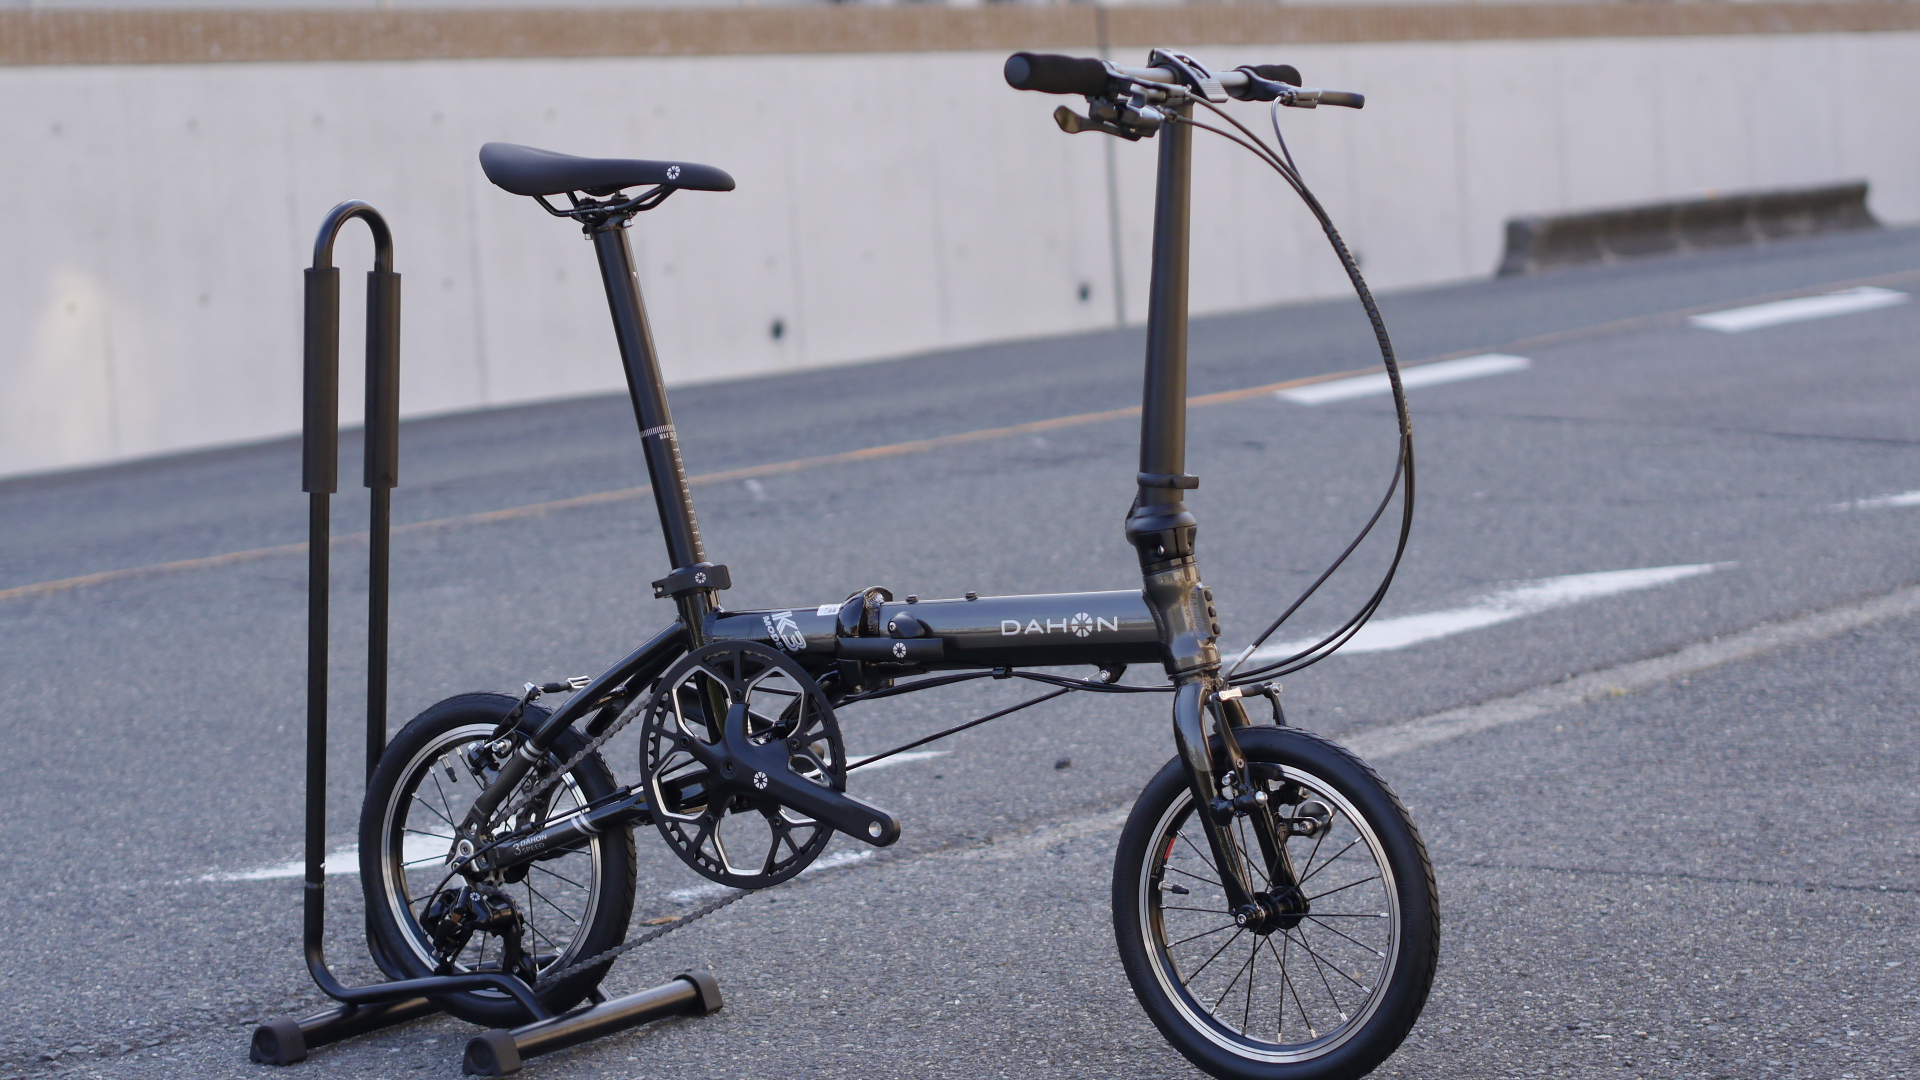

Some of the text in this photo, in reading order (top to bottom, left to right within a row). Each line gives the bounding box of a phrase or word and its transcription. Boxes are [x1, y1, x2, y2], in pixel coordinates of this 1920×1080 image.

[771, 610, 807, 652] K3
[1001, 612, 1118, 637] DAHON
[520, 833, 547, 847] DAHON
[512, 842, 522, 856] 3
[521, 842, 545, 854] SPEED
